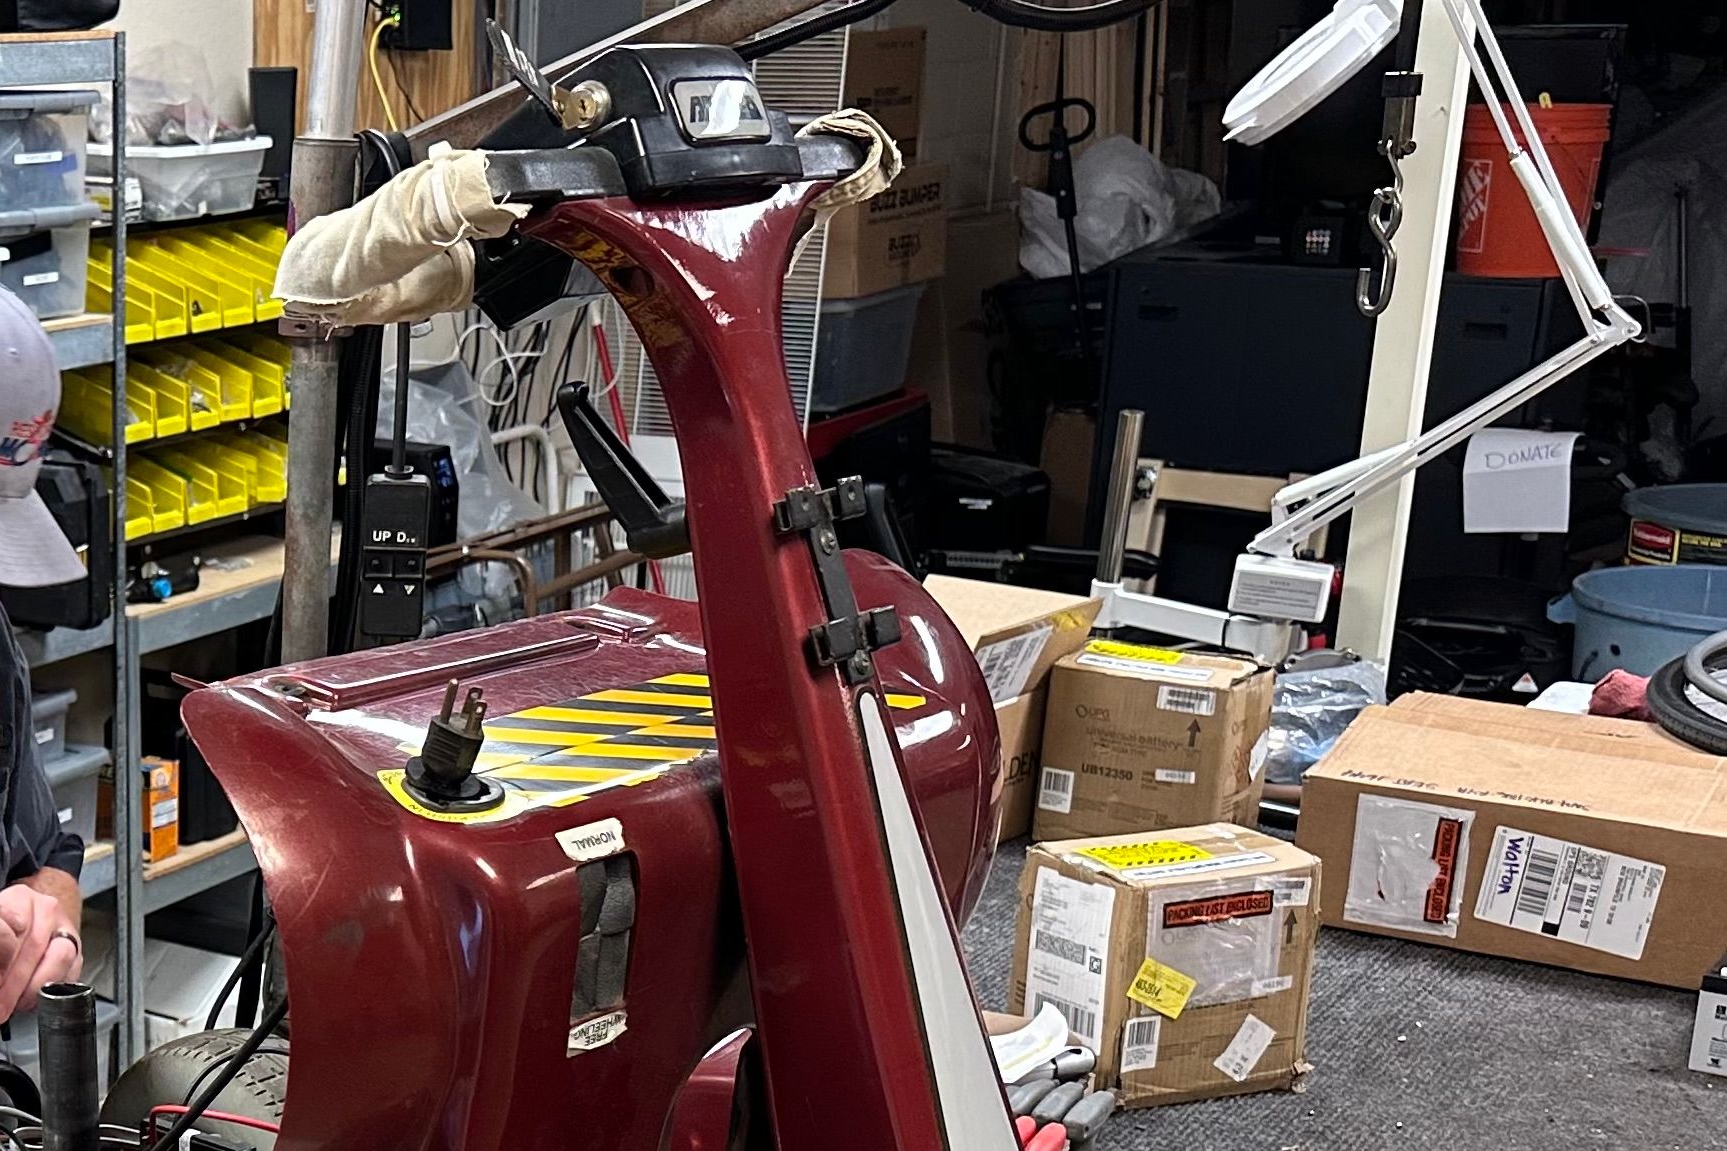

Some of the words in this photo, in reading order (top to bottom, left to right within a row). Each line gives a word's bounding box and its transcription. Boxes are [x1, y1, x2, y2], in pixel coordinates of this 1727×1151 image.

[1485, 442, 1562, 469] DONATE
[372, 530, 392, 542] UP
[1081, 763, 1134, 781] UB12350
[571, 830, 617, 851] NORMAL
[1439, 822, 1456, 857] PACKING
[1167, 902, 1205, 921] PACKING
[1204, 903, 1225, 917] LIST
[1226, 897, 1269, 914] ENCLOSED
[585, 1030, 608, 1047] FREE
